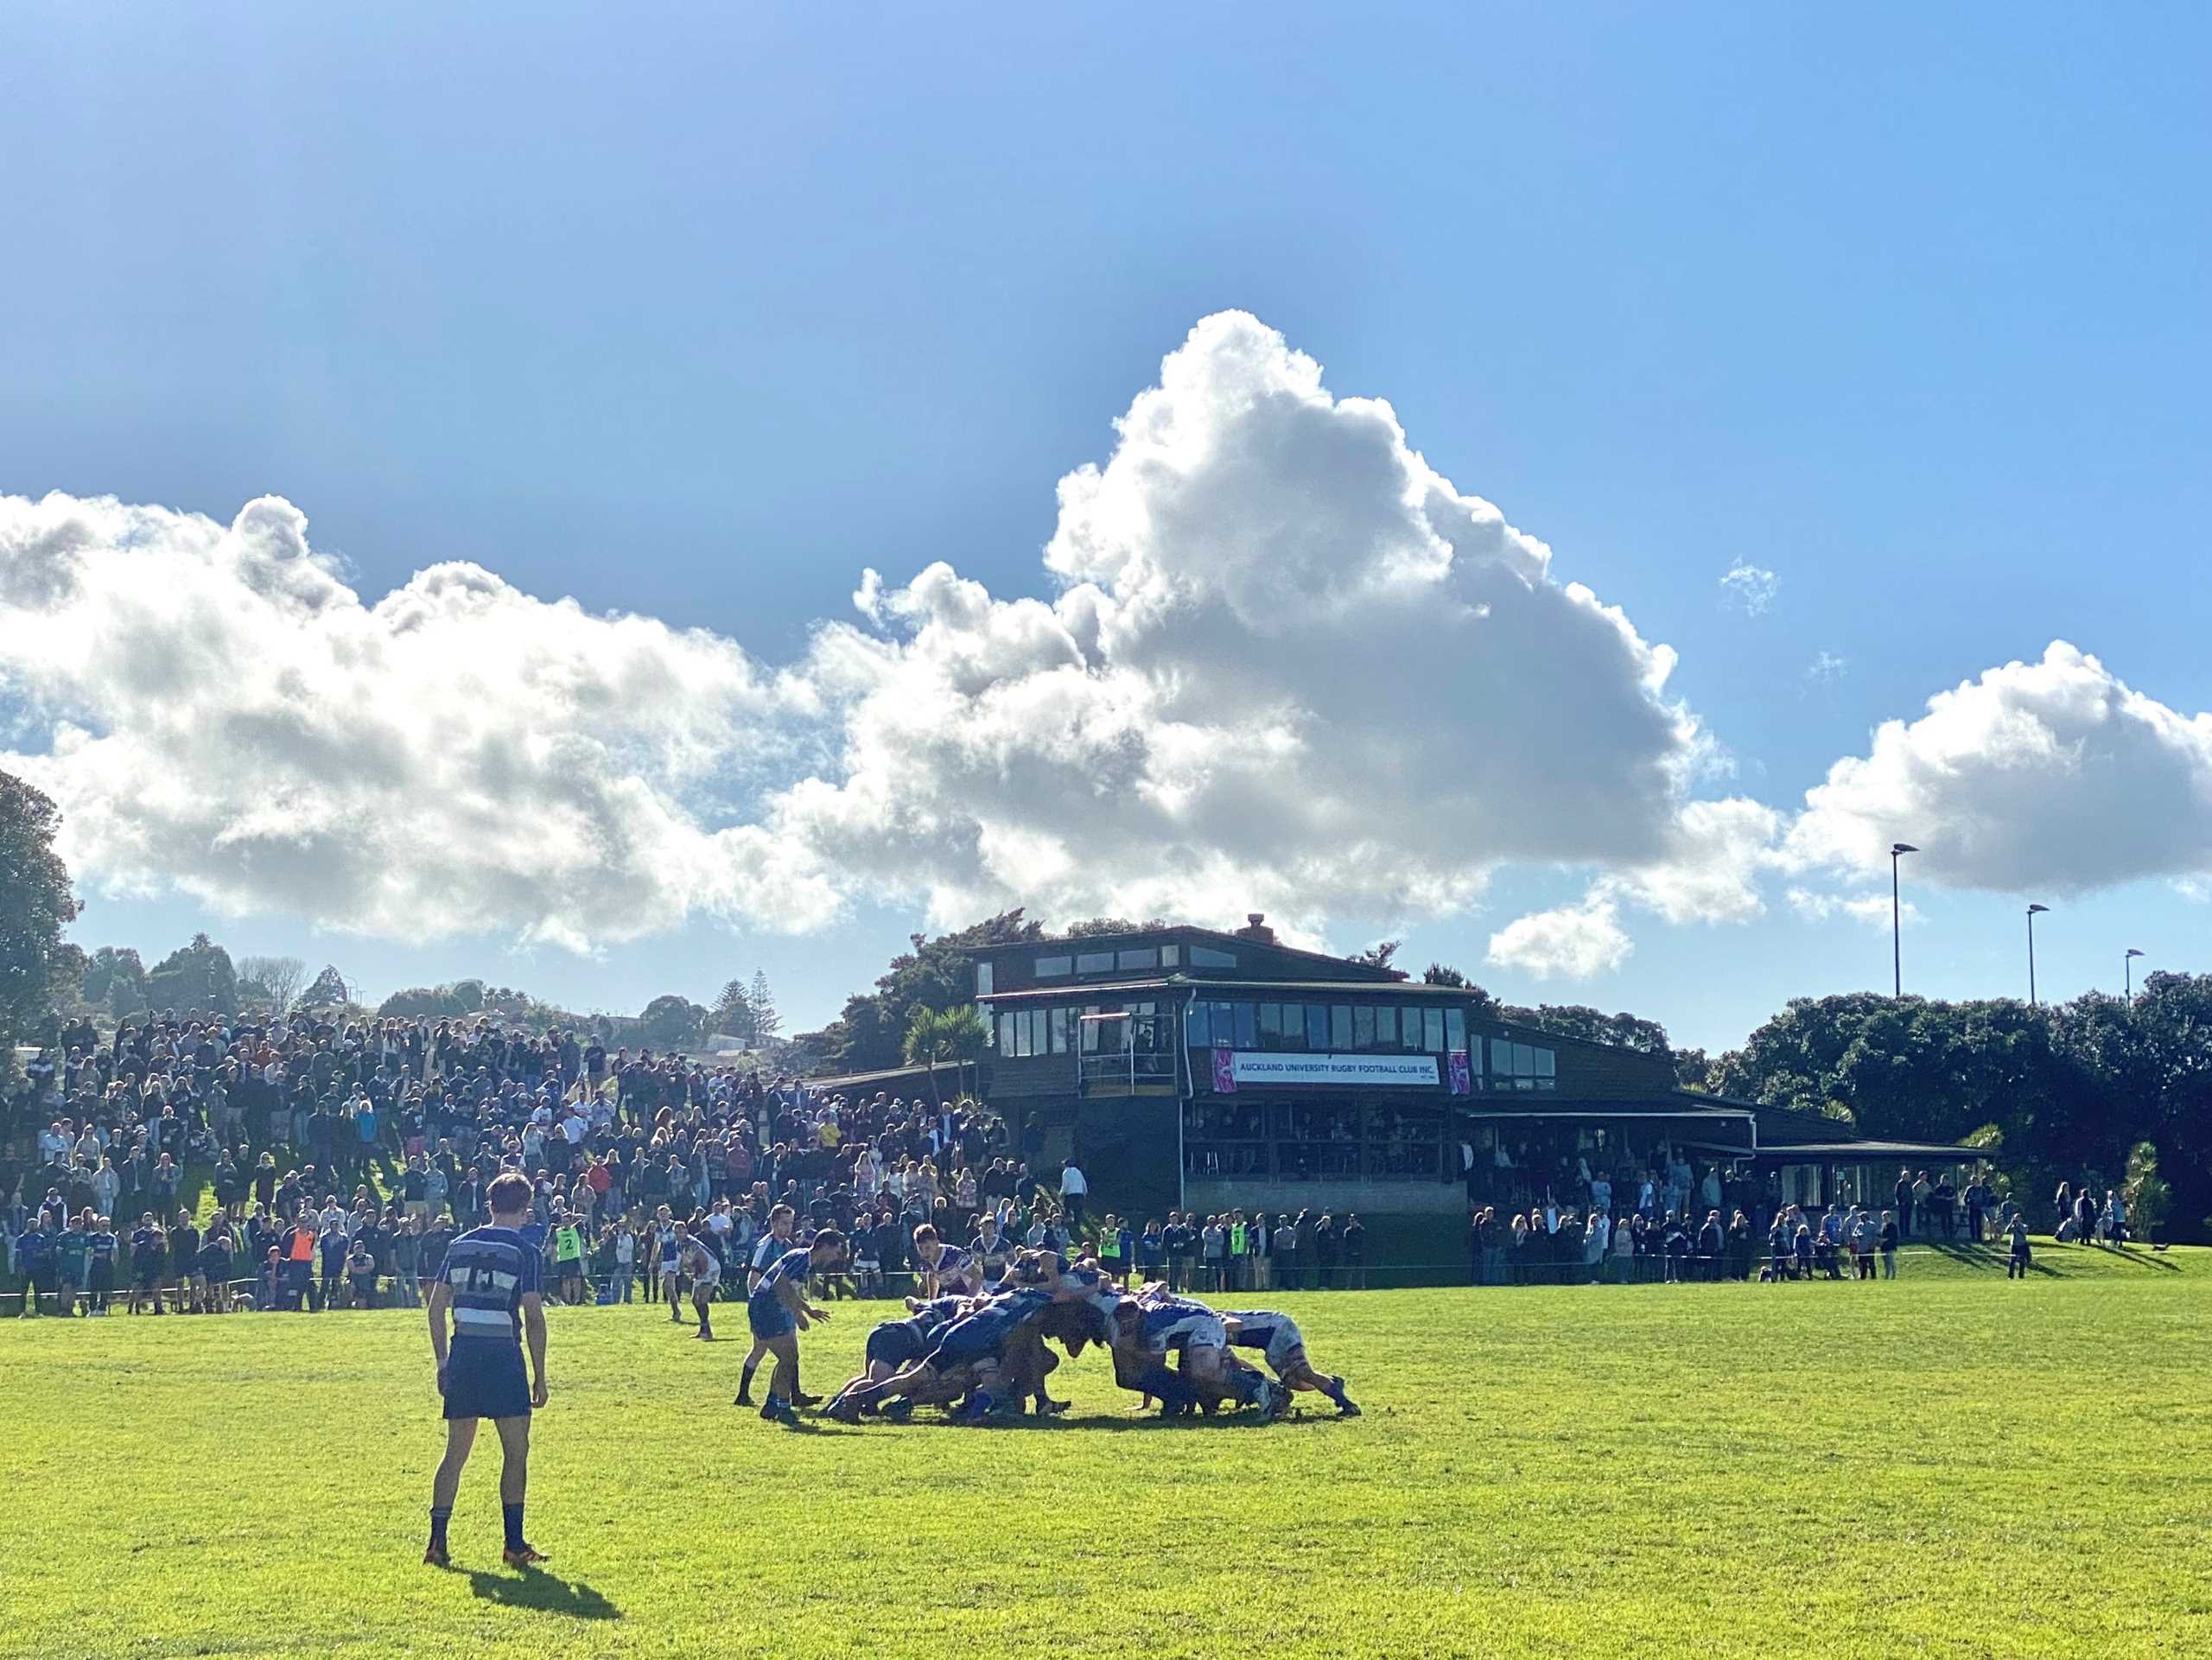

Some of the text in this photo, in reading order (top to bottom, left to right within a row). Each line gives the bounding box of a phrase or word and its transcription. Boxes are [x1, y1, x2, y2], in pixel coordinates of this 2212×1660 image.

[1240, 1063, 1284, 1072] AUCKLAND
[1285, 1064, 1329, 1072] UNIVERSITY
[1331, 1064, 1357, 1072] RUGBY
[1358, 1065, 1397, 1073] FOOTBALL
[1399, 1065, 1418, 1073] CLUB
[565, 1239, 574, 1250] 2
